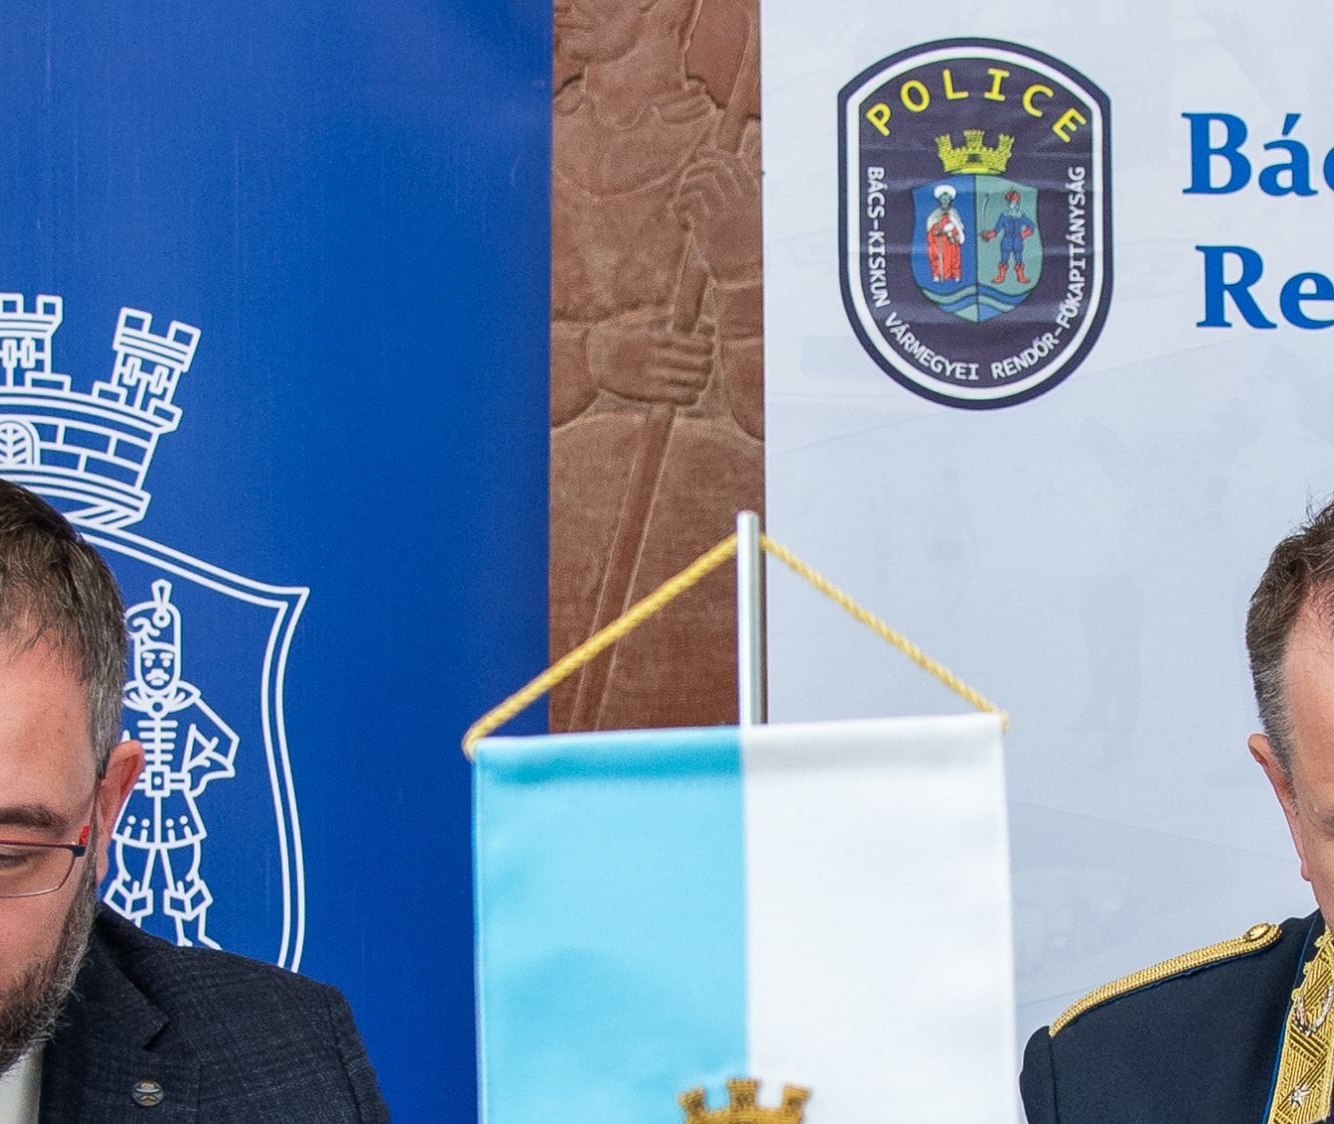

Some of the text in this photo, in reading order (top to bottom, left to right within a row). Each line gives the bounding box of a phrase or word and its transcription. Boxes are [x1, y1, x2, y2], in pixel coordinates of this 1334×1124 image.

[866, 67, 1087, 143] POLICE
[867, 165, 1086, 381] BÁCS-KISKUN VÁRMEGYEI RENDŐR-FŐKAPITÁNYSÁG
